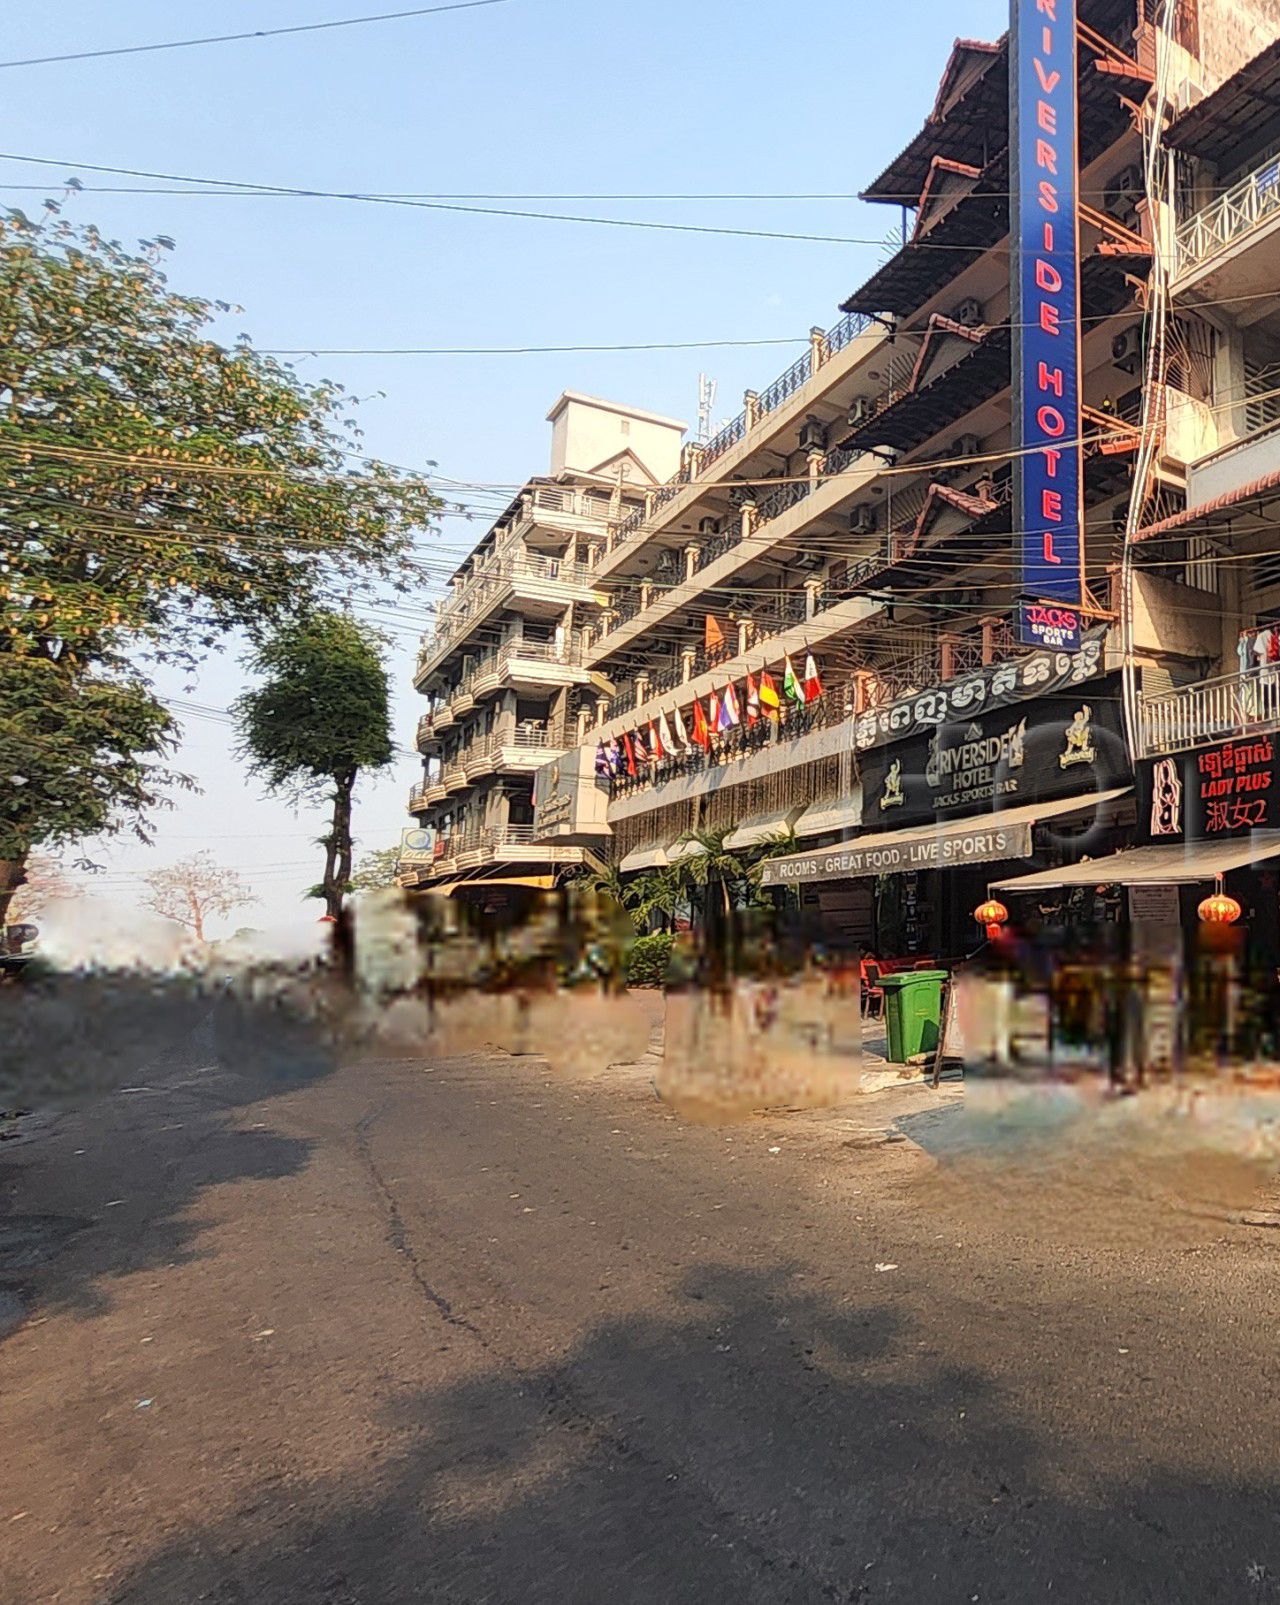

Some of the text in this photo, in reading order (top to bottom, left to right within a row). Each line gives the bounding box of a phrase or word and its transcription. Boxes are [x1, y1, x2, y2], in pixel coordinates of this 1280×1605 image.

[1033, 0, 1065, 564] RIVERSIDE HOTEL
[1024, 605, 1077, 630] JACKS
[1031, 624, 1074, 640] SPORTS
[1043, 635, 1064, 646] BAR
[940, 733, 1009, 775] RIVERSIDE
[953, 766, 994, 790] HOTEL
[1201, 771, 1272, 798] LADY PLUS
[932, 779, 1018, 808] JACKS SPORTS BAR
[779, 860, 817, 878] ROOMS
[825, 854, 862, 872] GREAT
[865, 850, 900, 867] FOOD
[910, 843, 938, 862] LIVE
[943, 833, 1006, 857] SPORTS
